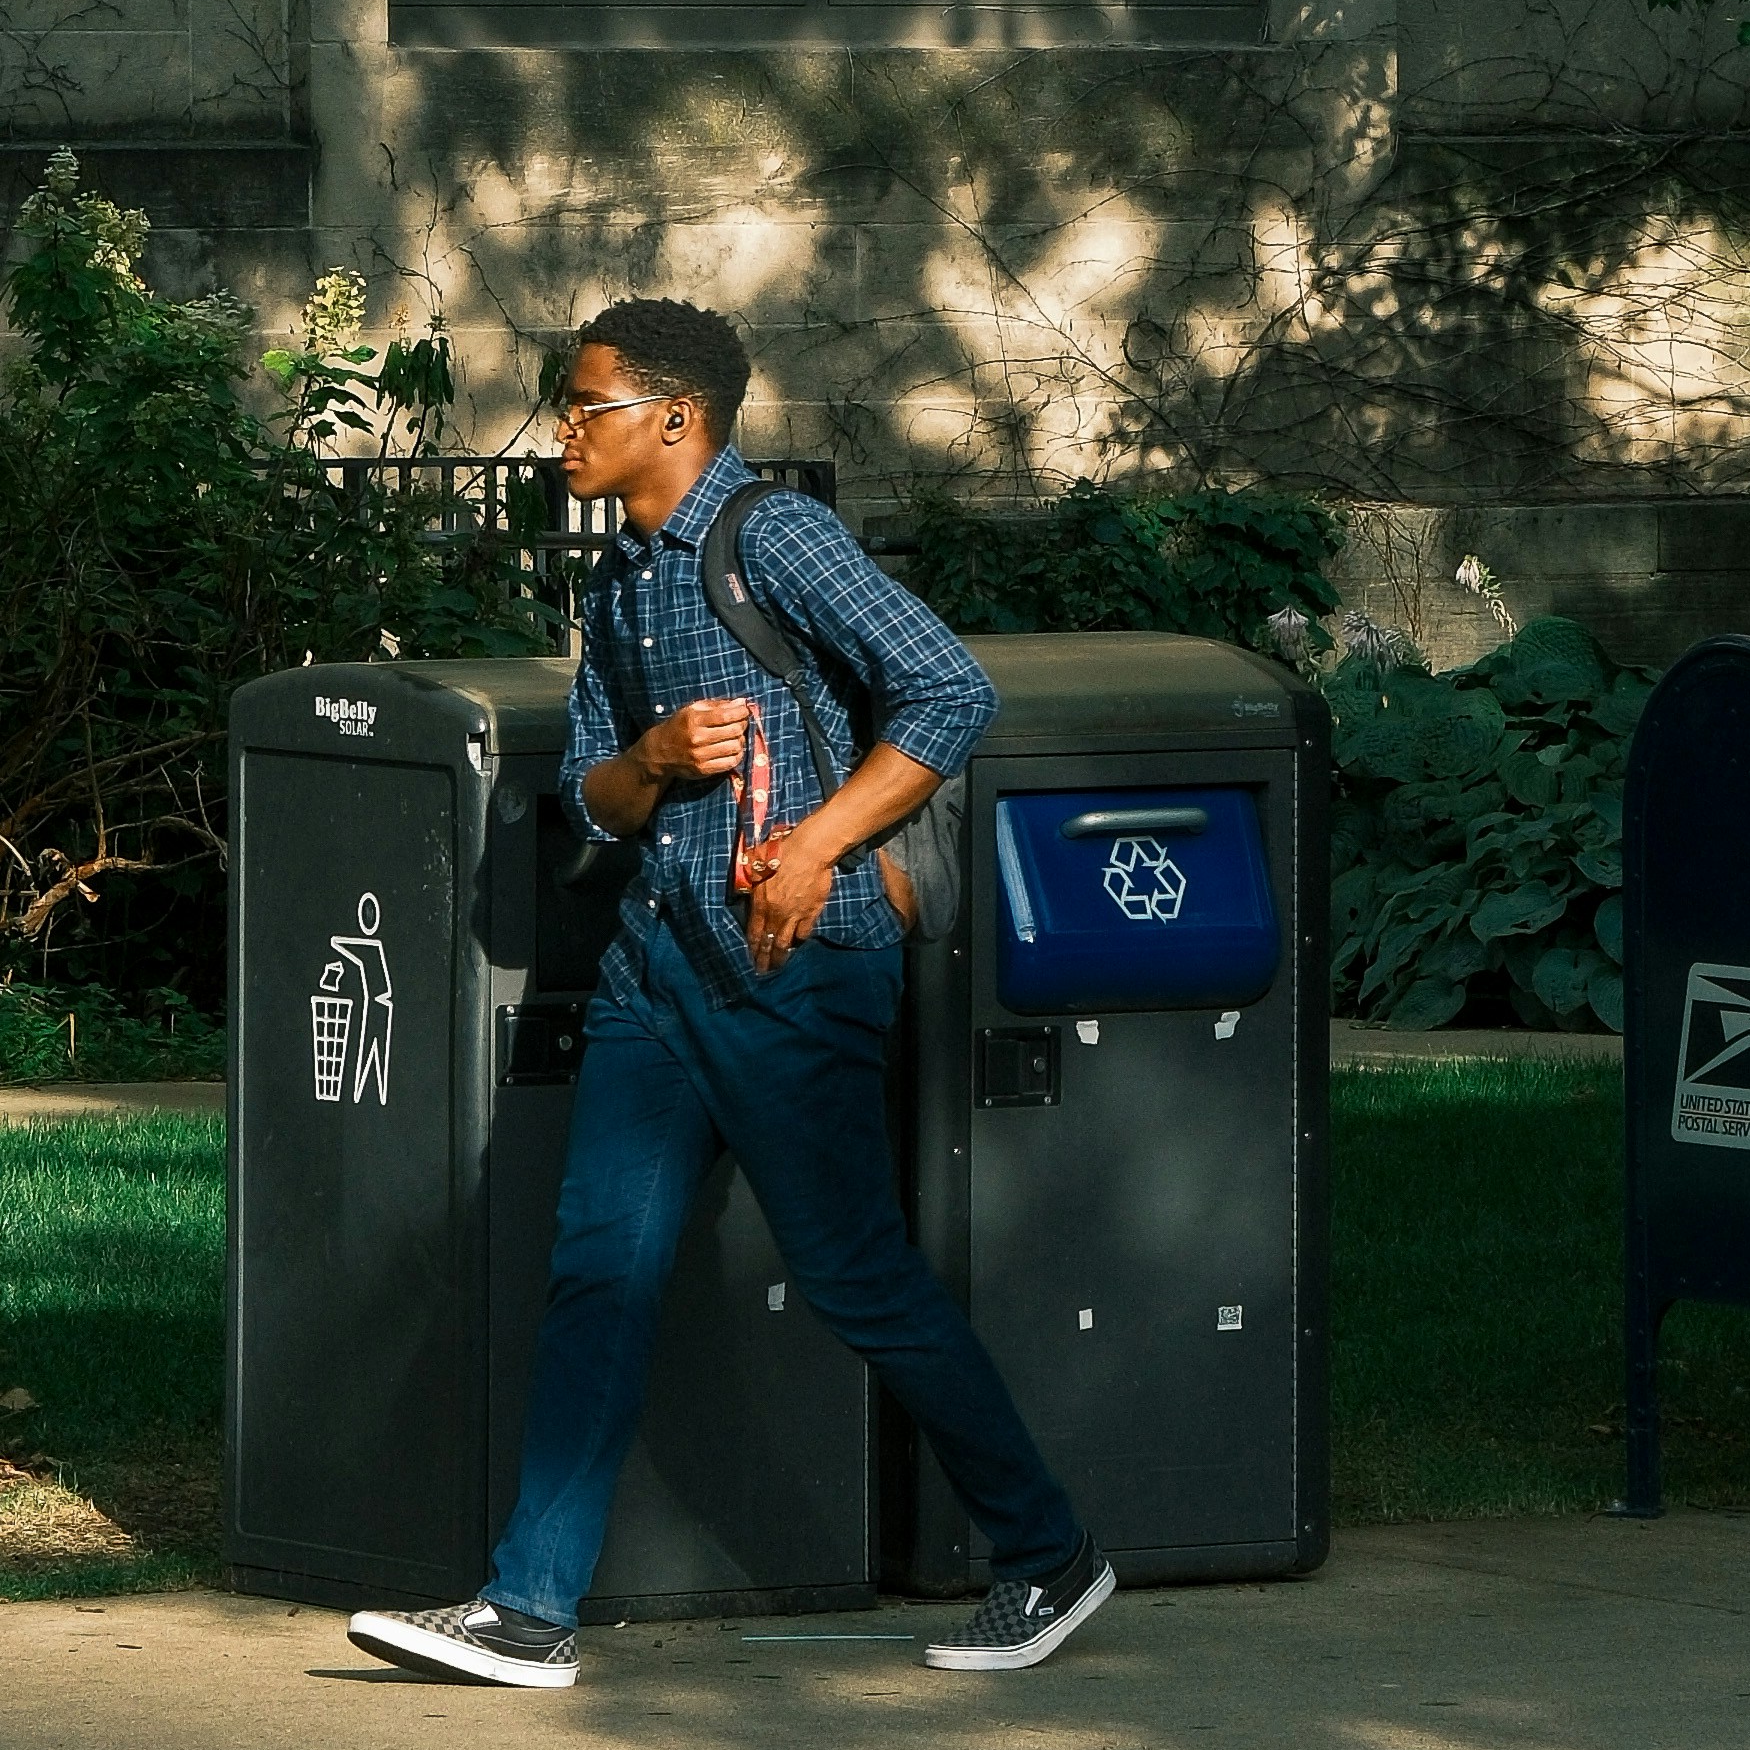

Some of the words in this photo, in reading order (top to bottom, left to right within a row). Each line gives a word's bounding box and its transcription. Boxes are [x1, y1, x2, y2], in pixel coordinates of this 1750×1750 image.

[314, 696, 378, 725] BigBelly
[339, 720, 369, 737] SOLAR
[1680, 1093, 1723, 1113] UNITED
[1677, 1116, 1719, 1134] POSTAL
